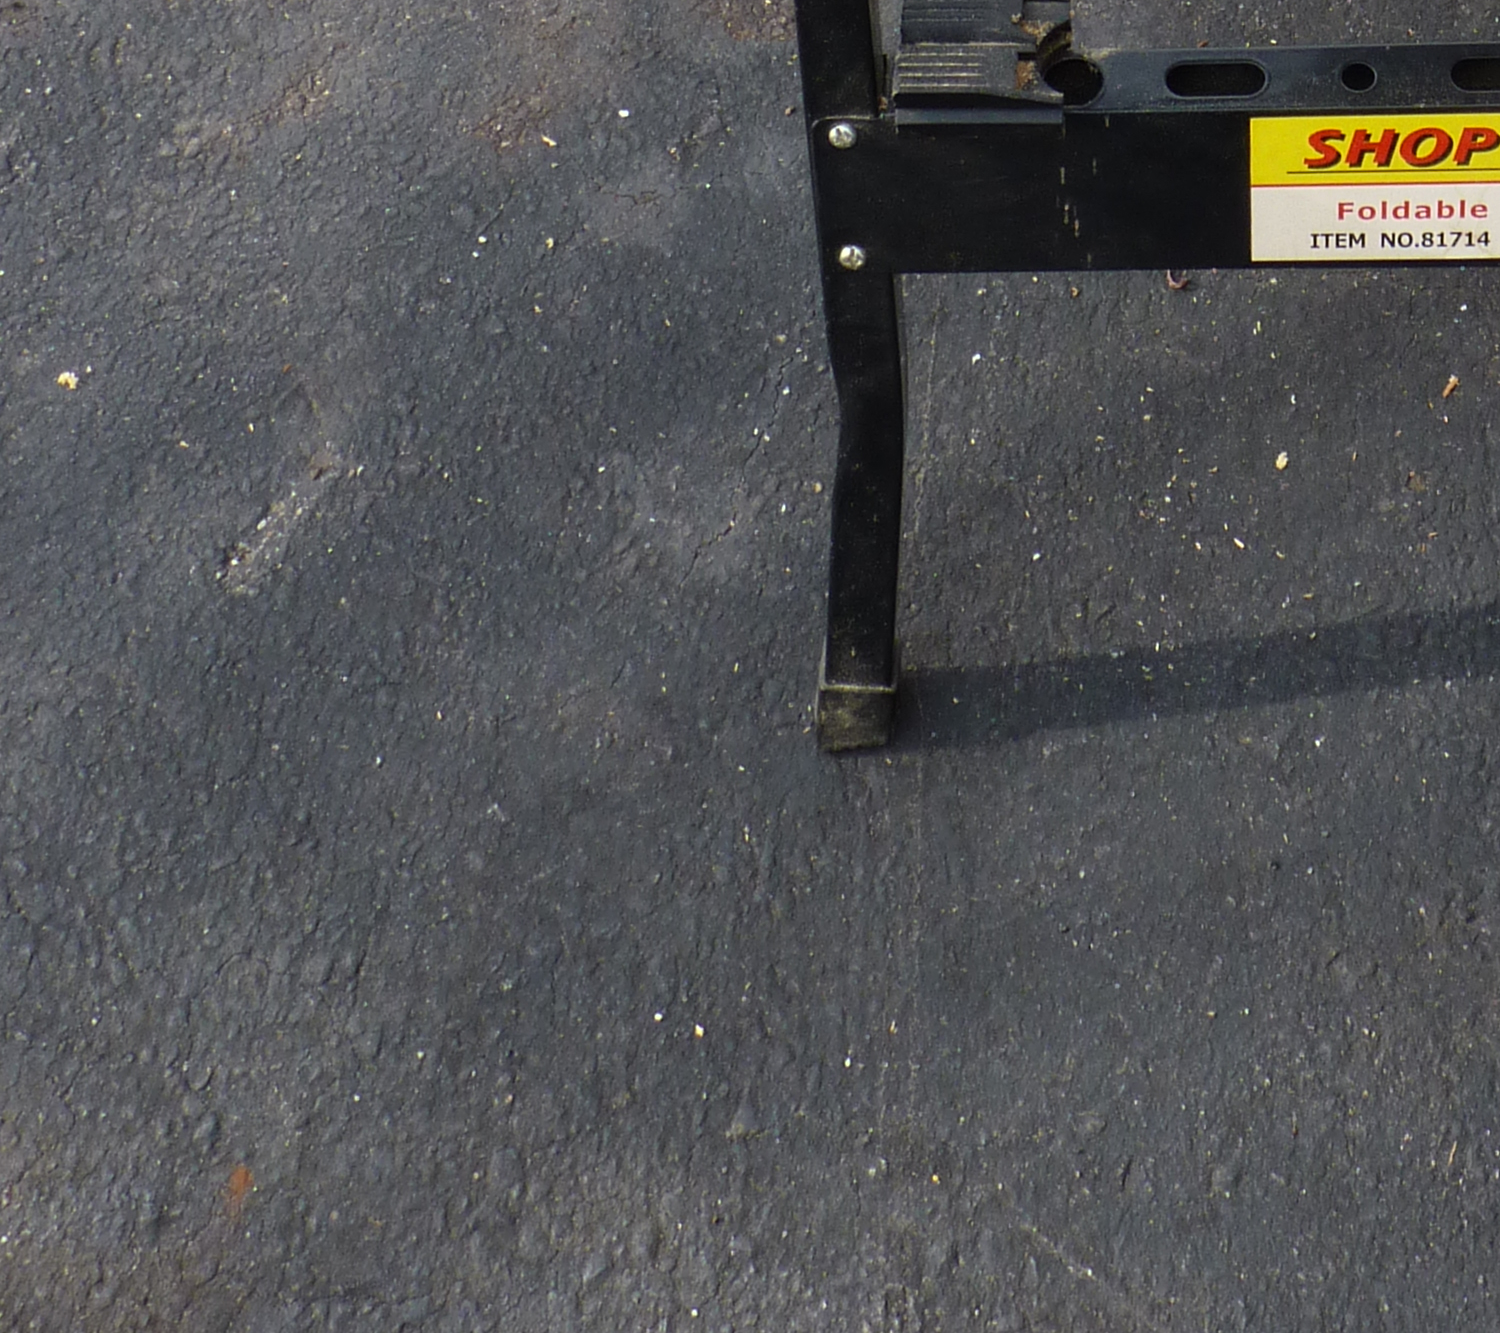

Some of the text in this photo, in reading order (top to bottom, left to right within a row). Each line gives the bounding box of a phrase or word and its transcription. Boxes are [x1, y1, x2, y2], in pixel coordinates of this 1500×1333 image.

[1337, 200, 1488, 221] Foldable
[1310, 233, 1366, 249] ITEM
[1381, 231, 1491, 248] NO.81714
